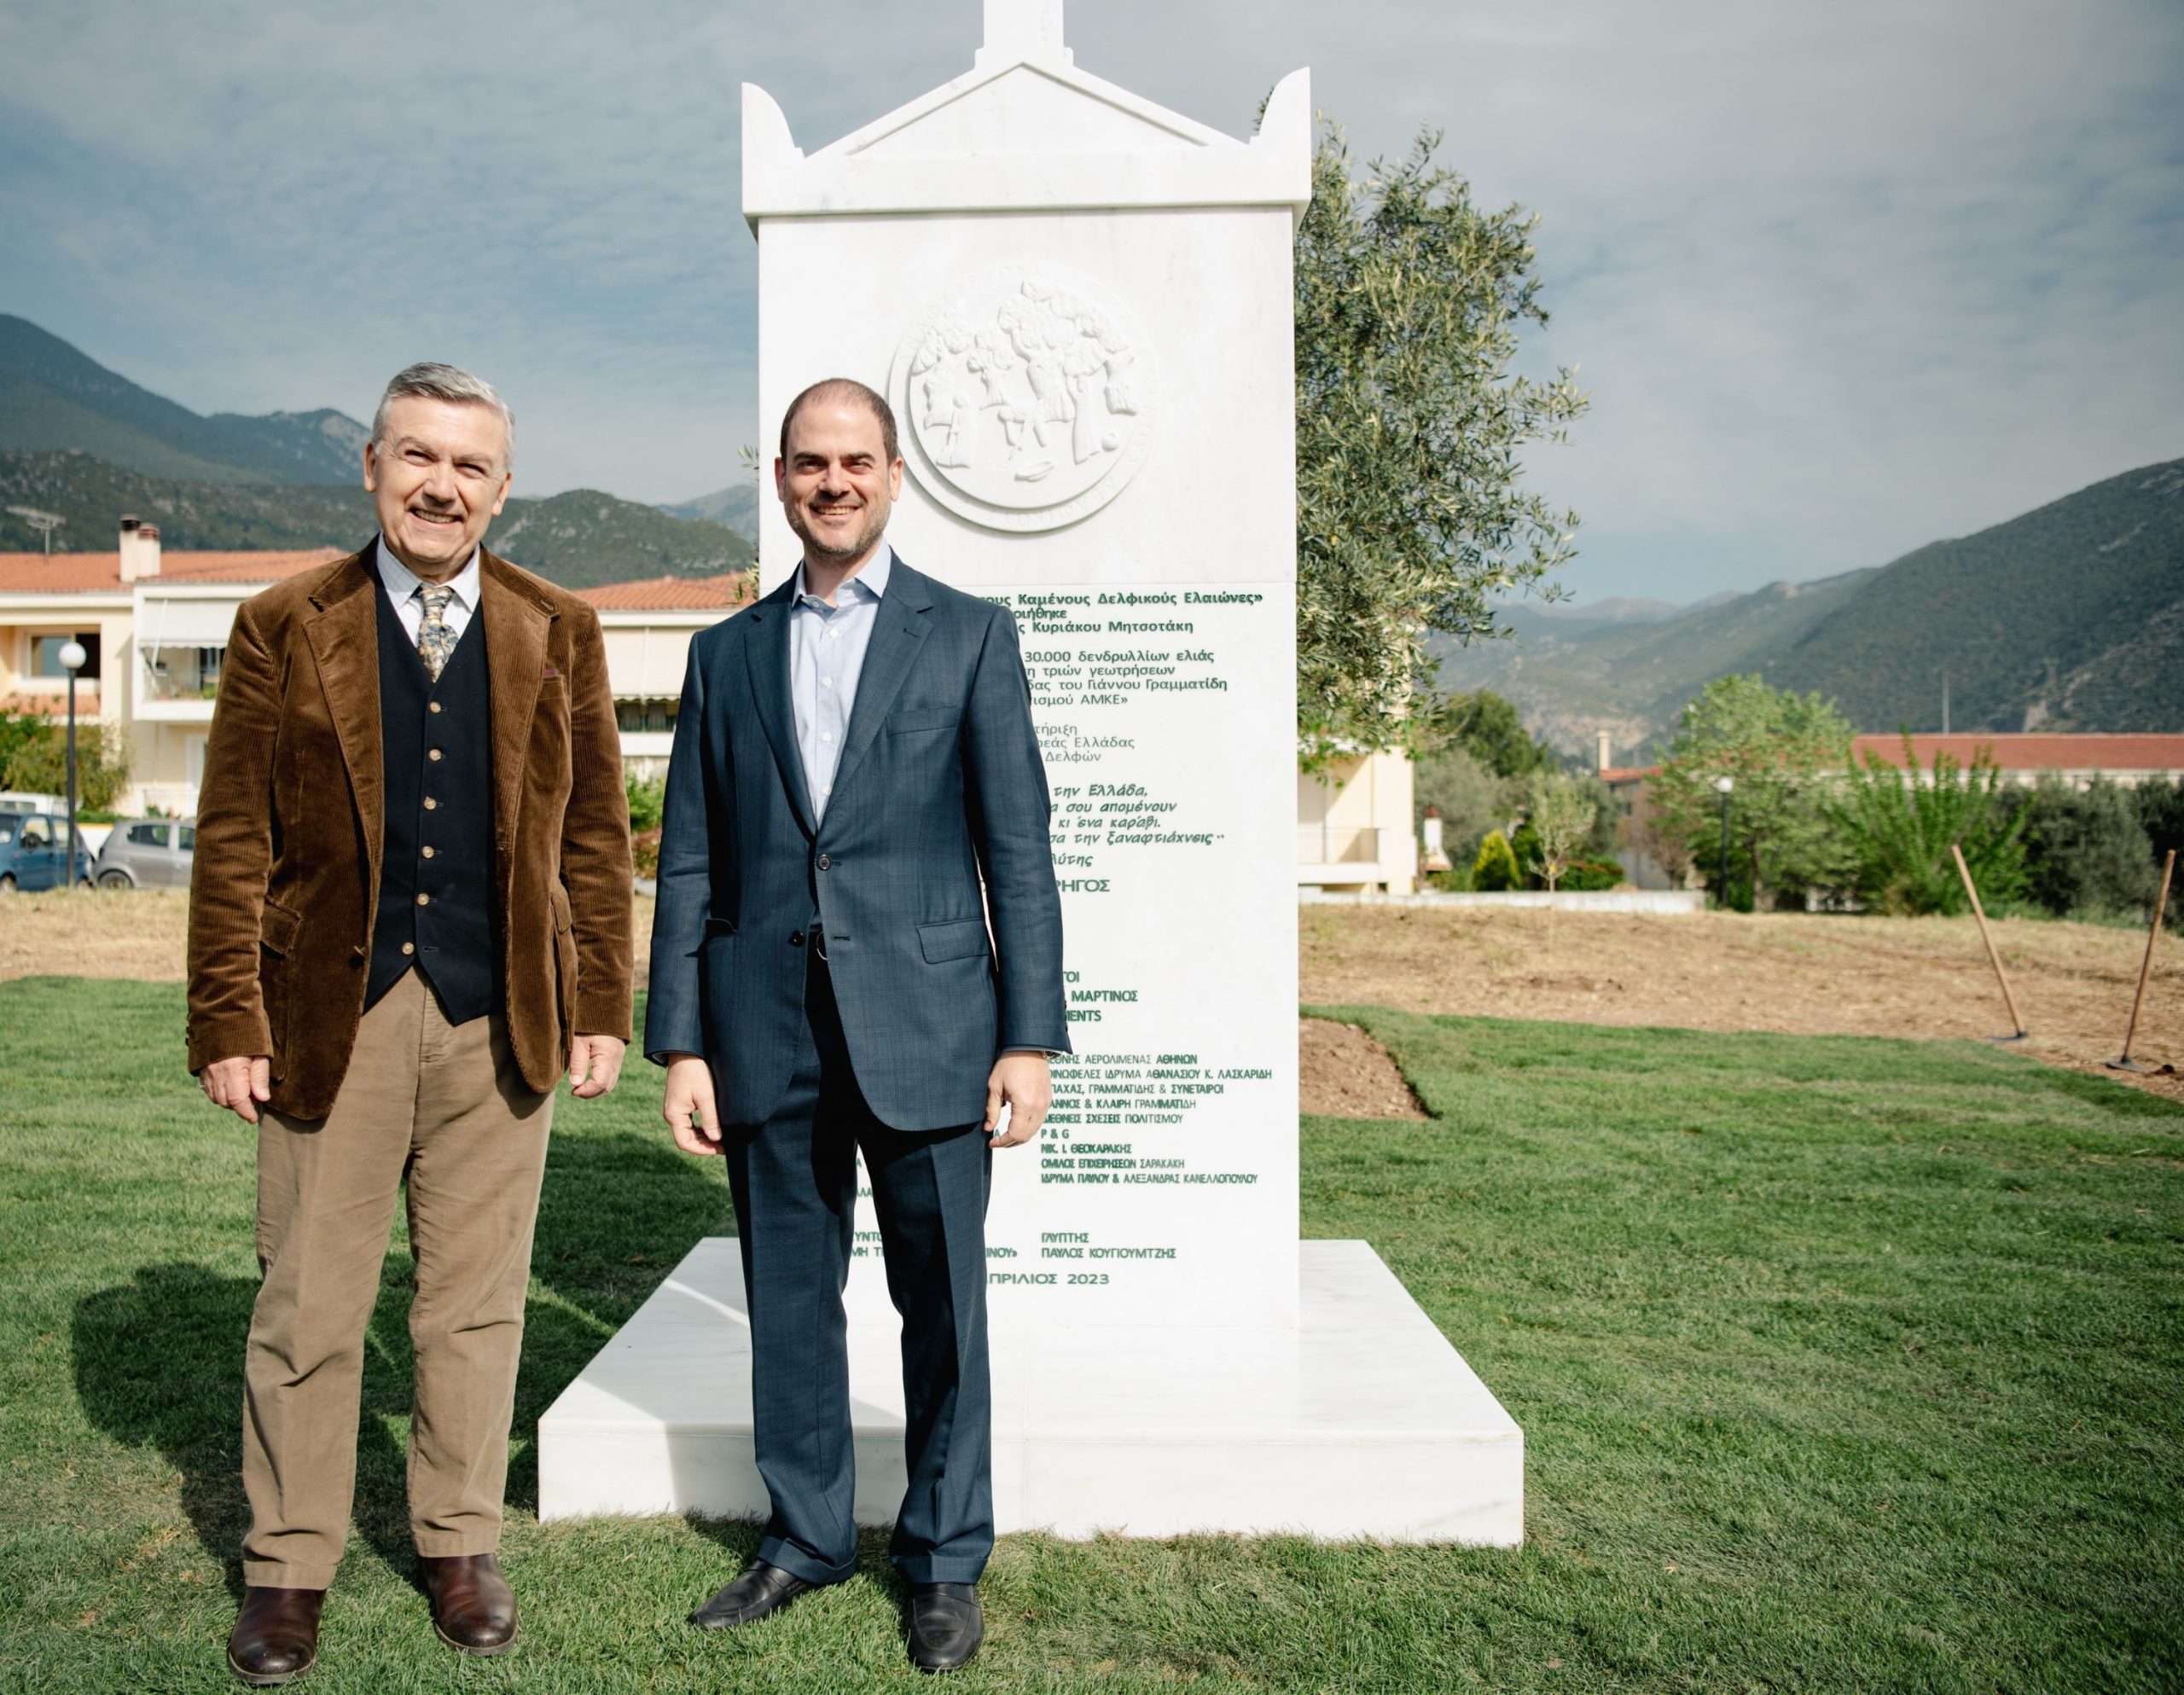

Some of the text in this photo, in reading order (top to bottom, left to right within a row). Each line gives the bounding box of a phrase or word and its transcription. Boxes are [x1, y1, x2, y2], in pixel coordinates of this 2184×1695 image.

[1018, 593, 1091, 607] Καμένους
[1097, 591, 1177, 607] Δελφικούς
[1184, 591, 1263, 606] Ελαιώνες»
[1032, 621, 1102, 634] Κυριάκου
[1108, 619, 1194, 634] Μητσοτάκη
[1025, 649, 1214, 665] 30.000 δενδρυλλίων ελιάς
[1043, 665, 1082, 678] τριών
[1089, 664, 1176, 677] γεωτρήσεων
[1059, 682, 1083, 690] του
[1088, 678, 1141, 690] Γιάννου
[1146, 677, 1227, 692] Γραμματίδη
[1032, 694, 1073, 707] ισμού
[1074, 736, 1136, 748] Ελλάδας
[1045, 750, 1101, 763] Δελφών
[1054, 784, 1148, 798] την Ελλάδα,
[1066, 803, 1093, 812] σου
[1100, 801, 1178, 814] απομένουν
[1058, 816, 1161, 829] κι ένα καράβι.
[1074, 833, 1101, 846] την
[1071, 990, 1138, 1002] ΜΑΡΤΙΝΟΣ
[1085, 1054, 1151, 1065] ΑΕΡΟΛΙΜΕΝΑΣ
[1156, 1054, 1197, 1065] ΑΘΗΝΩΝ
[1105, 1069, 1141, 1079] ΙΔΡΥΜΑ
[1146, 1069, 1200, 1079] ΑΘΑΝΑΣΙΟΥ
[1217, 1069, 1272, 1079] ΛΑΣΚΑΡΙΔΗ
[1089, 1084, 1155, 1094] ΓΡΑΜΜΑΤΙΔΗΣ
[1159, 1084, 1166, 1094] &
[1170, 1084, 1223, 1094] ΣΥΝΕΤΑΙΡΟΙ
[1084, 1099, 1092, 1109] &
[1096, 1099, 1131, 1109] ΚΛΑΙΡΗ
[1135, 1099, 1196, 1109] ΓΡΑΜΜΑΤΙΔΗ
[1085, 1114, 1121, 1124] ΣΧΕΣΕΙΣ
[1125, 1113, 1182, 1123] ΠΟΛΙΤΙΣΜΟΥ
[1050, 1129, 1059, 1139] &
[1061, 1129, 1069, 1139] G
[1070, 1143, 1132, 1154] ΘΕΟΧΑΡΑΚΗΣ
[1041, 1158, 1184, 1169] ΟΜΙΛΟΣ ΕΠΙΧΕΙΡΗΣΕΩΝ ΣΑΡΑΚΑΚΗ
[1041, 1173, 1258, 1184] ΙΔΡΥΜΑ ΠΑΥΛΟΥ & ΑΛΕΞΑΝΔΡΑΣ ΚΑΝΕΛΛΟΠΟΥΛΟΥ
[1041, 1233, 1089, 1243] ΓΛΥΠΤΗΣ
[1042, 1248, 1176, 1259] ΠΑΥΛΟΣ ΚΟΥΓΙΟΥΜΤΖΗΣ
[1067, 1274, 1109, 1285] 2023
